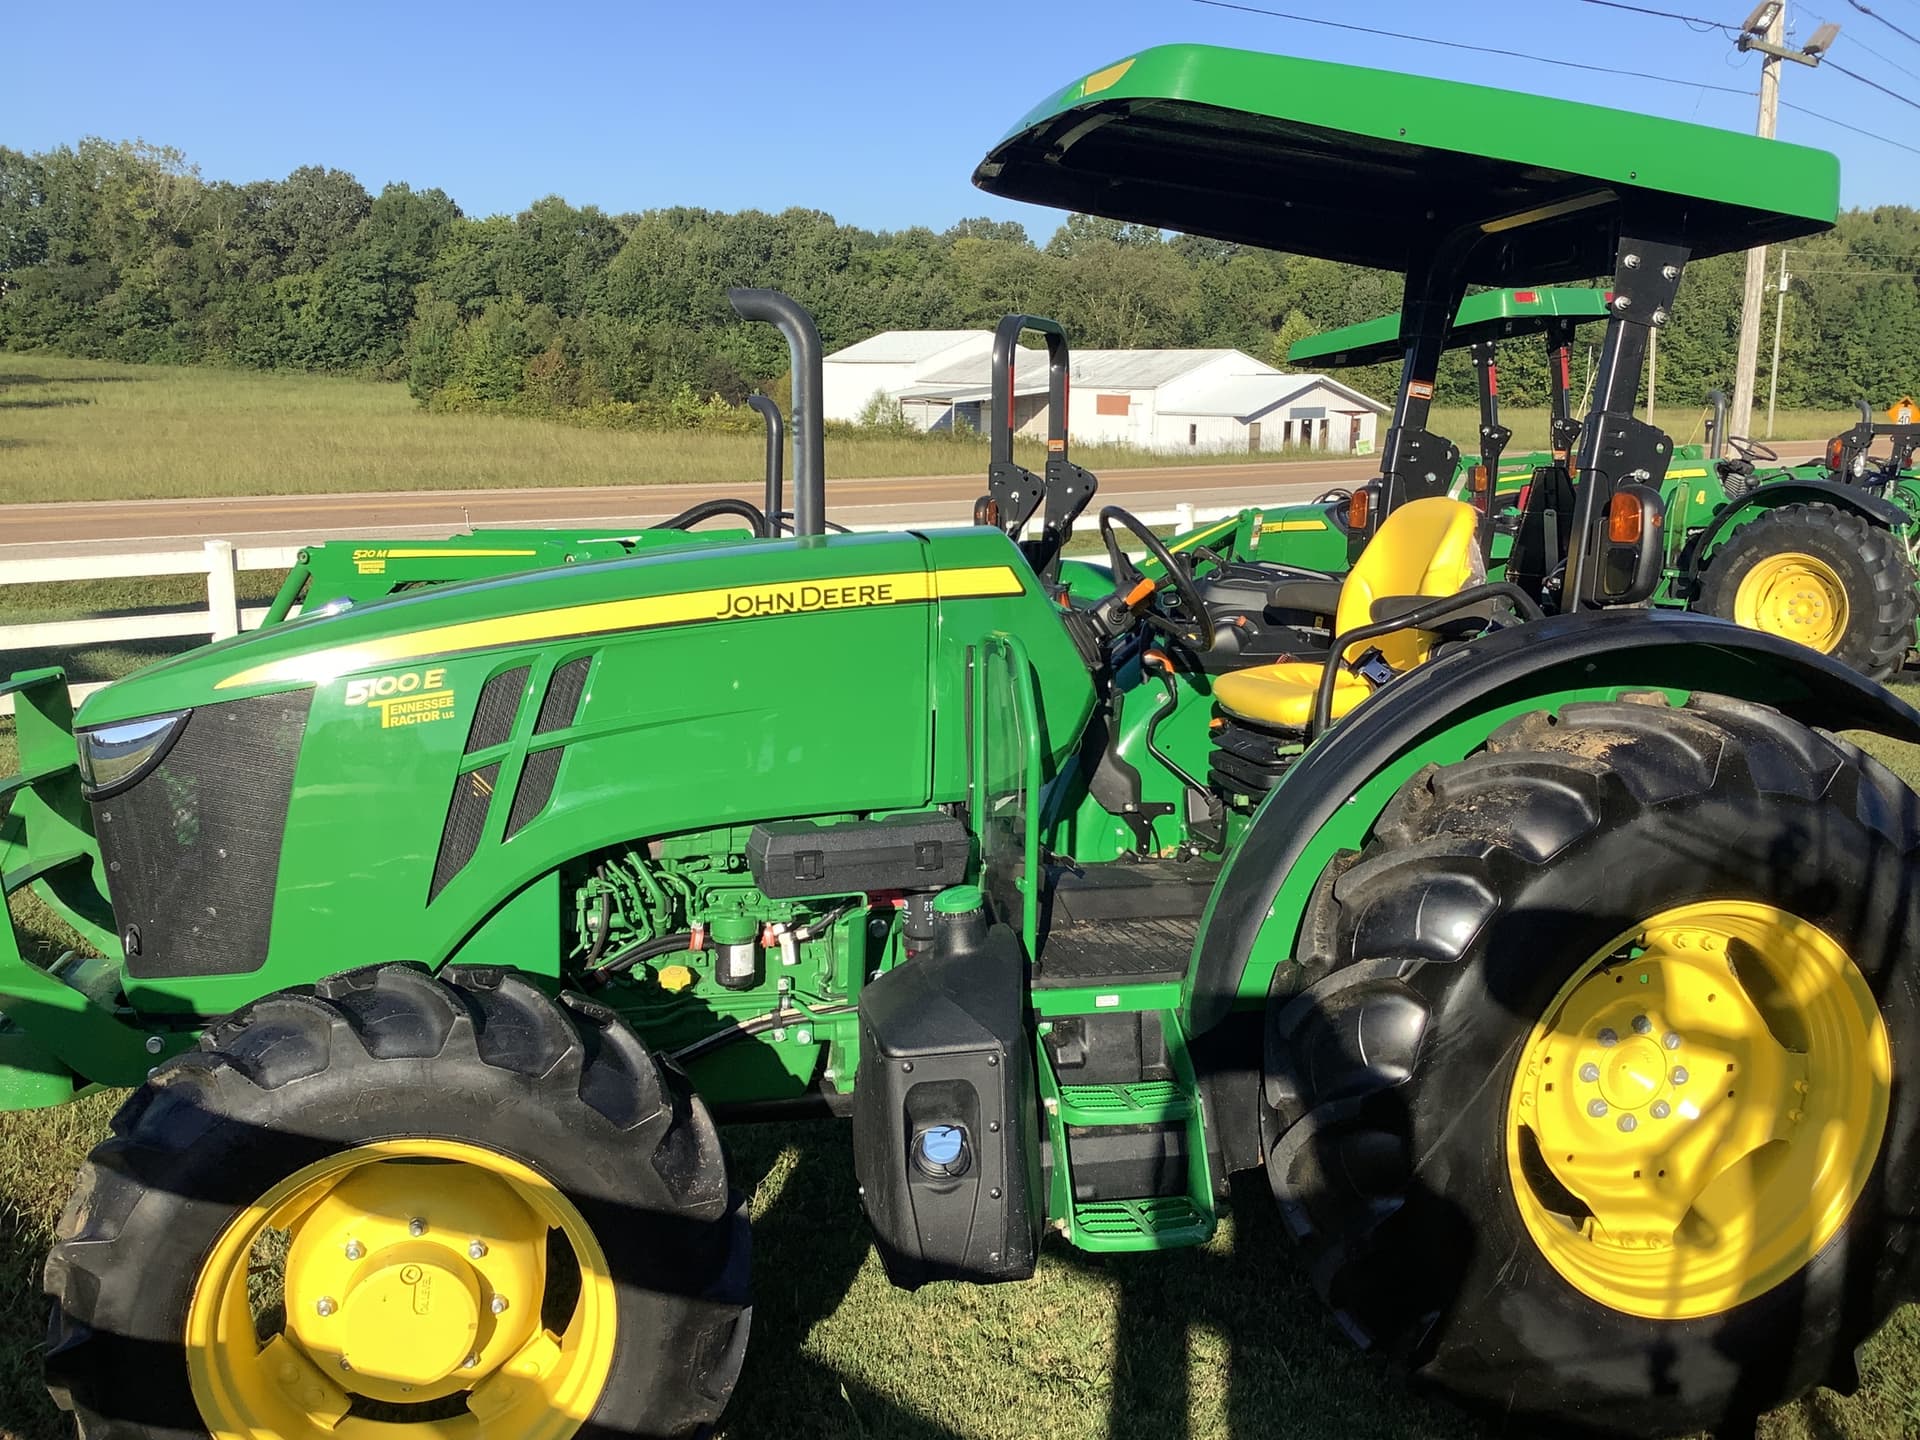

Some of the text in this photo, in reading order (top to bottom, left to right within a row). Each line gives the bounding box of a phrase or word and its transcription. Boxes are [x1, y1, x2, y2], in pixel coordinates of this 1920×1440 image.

[1695, 490, 1705, 504] 4
[352, 550, 376, 559] 520
[716, 584, 892, 616] JOHN DEERE
[345, 668, 447, 706] 5100 E
[368, 689, 455, 728] TENNESSEE
